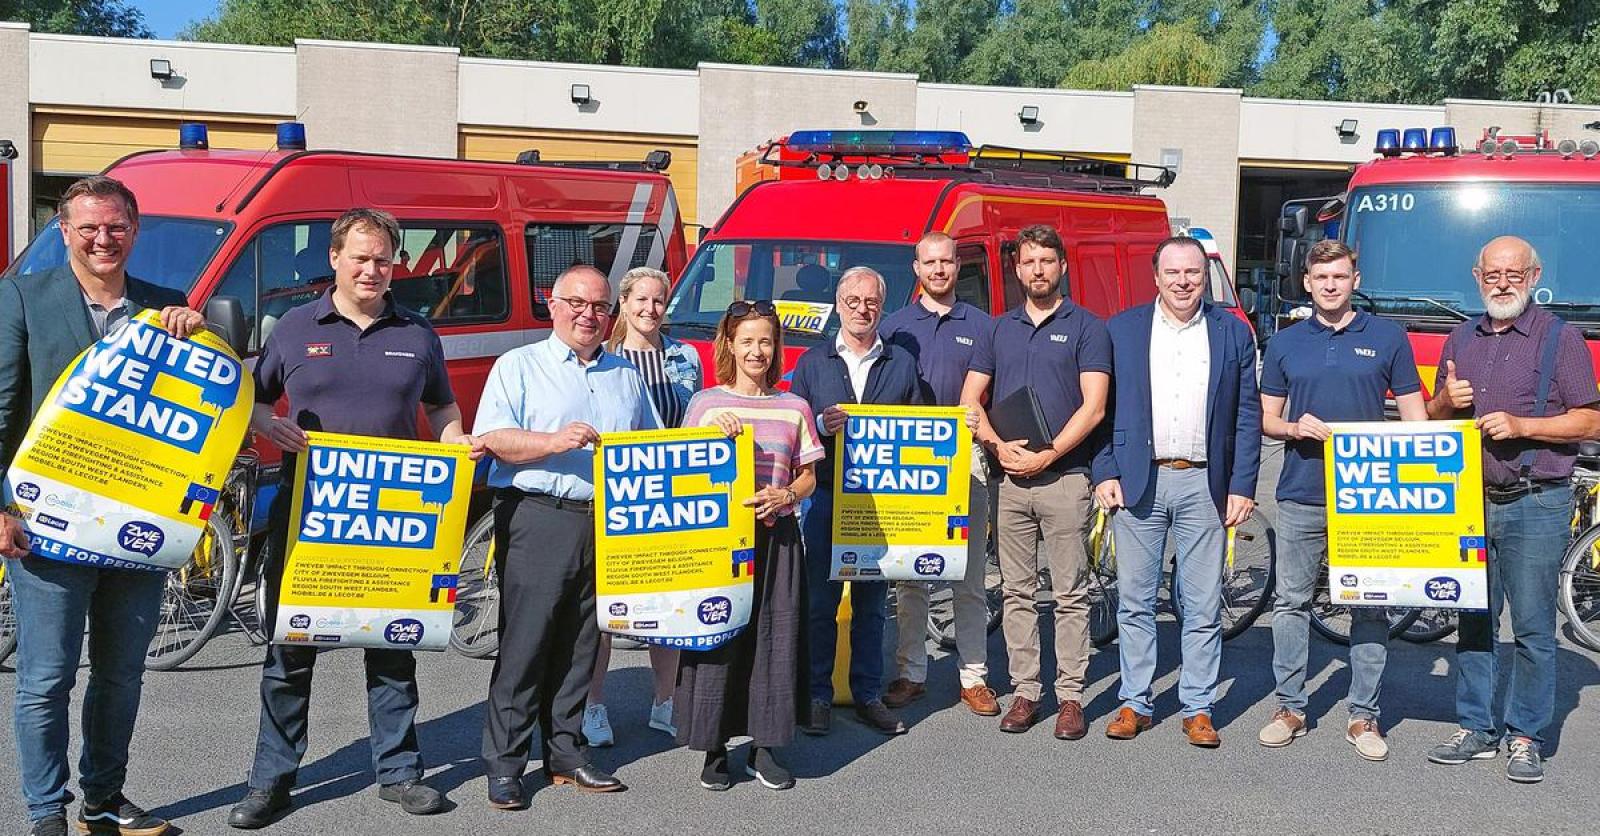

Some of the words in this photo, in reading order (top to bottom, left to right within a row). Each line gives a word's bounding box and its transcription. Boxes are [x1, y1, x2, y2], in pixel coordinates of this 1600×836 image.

[1358, 193, 1415, 213] A310
[779, 313, 822, 330] UVIA
[103, 322, 237, 385] UNITED
[84, 345, 150, 391] WE
[61, 374, 199, 441] STAND
[847, 418, 953, 442] UNITED
[39, 432, 54, 442] CITY
[67, 443, 111, 461] ZWEVEGEM
[42, 426, 73, 440] ZWEVER
[105, 447, 139, 462] THROUGH
[846, 444, 894, 465] WE
[1336, 434, 1458, 458] UNITED
[31, 446, 60, 461] REGION
[61, 457, 86, 469] SOUTH
[88, 466, 109, 477] WEST
[62, 449, 112, 470] FIREFIGHTING
[120, 468, 164, 487] ASSISTANCE
[311, 448, 449, 485] UNITED
[607, 442, 731, 474] UNITED
[844, 468, 941, 491] STAND
[1336, 462, 1392, 484] WE
[309, 480, 372, 510] WE
[607, 474, 665, 502] WE
[1338, 487, 1447, 510] STAND
[302, 511, 428, 544] STAND
[608, 500, 721, 531] STAND
[123, 536, 157, 552] VER
[126, 523, 161, 542] ZWE
[27, 534, 63, 555] PLE
[65, 547, 101, 564] FOR
[702, 600, 729, 612] ZWE
[702, 610, 728, 622] VER
[389, 632, 418, 642] VER
[390, 624, 420, 633] ZWE
[666, 637, 693, 648] FOR
[697, 629, 738, 646] PEOPLE
